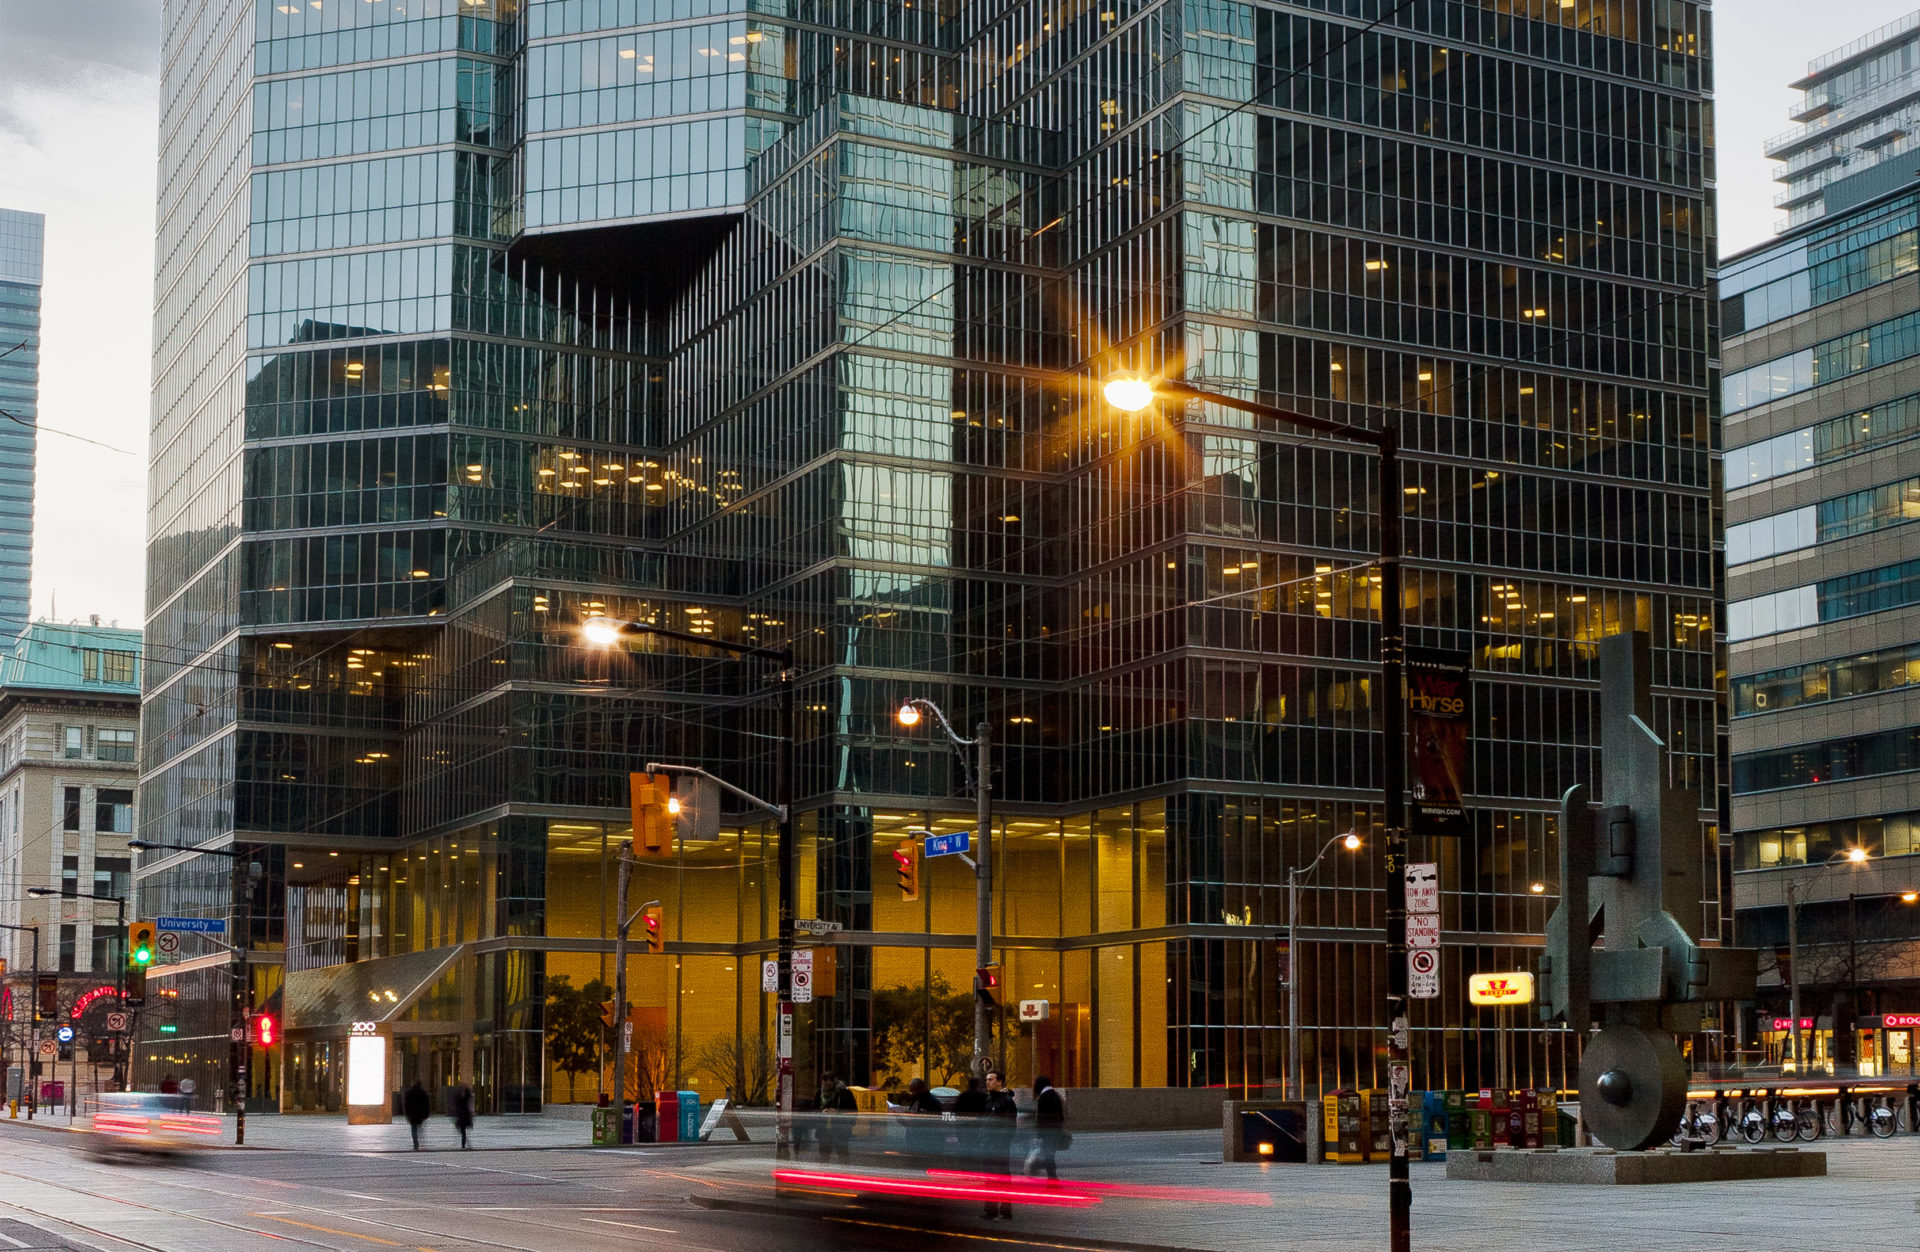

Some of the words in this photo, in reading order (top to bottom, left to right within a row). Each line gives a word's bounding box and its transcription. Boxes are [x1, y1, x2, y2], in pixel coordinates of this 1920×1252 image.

[1416, 674, 1460, 697] War
[1410, 688, 1464, 713] Horse
[1421, 807, 1461, 816] MIRVISH.COM
[932, 838, 948, 854] King
[955, 835, 961, 848] W
[1414, 898, 1430, 908] ZONE
[160, 918, 209, 931] University
[796, 921, 831, 931] UNIVERSITY
[1416, 917, 1429, 926] NO
[1408, 927, 1438, 937] STANDING
[351, 1021, 376, 1032] 200
